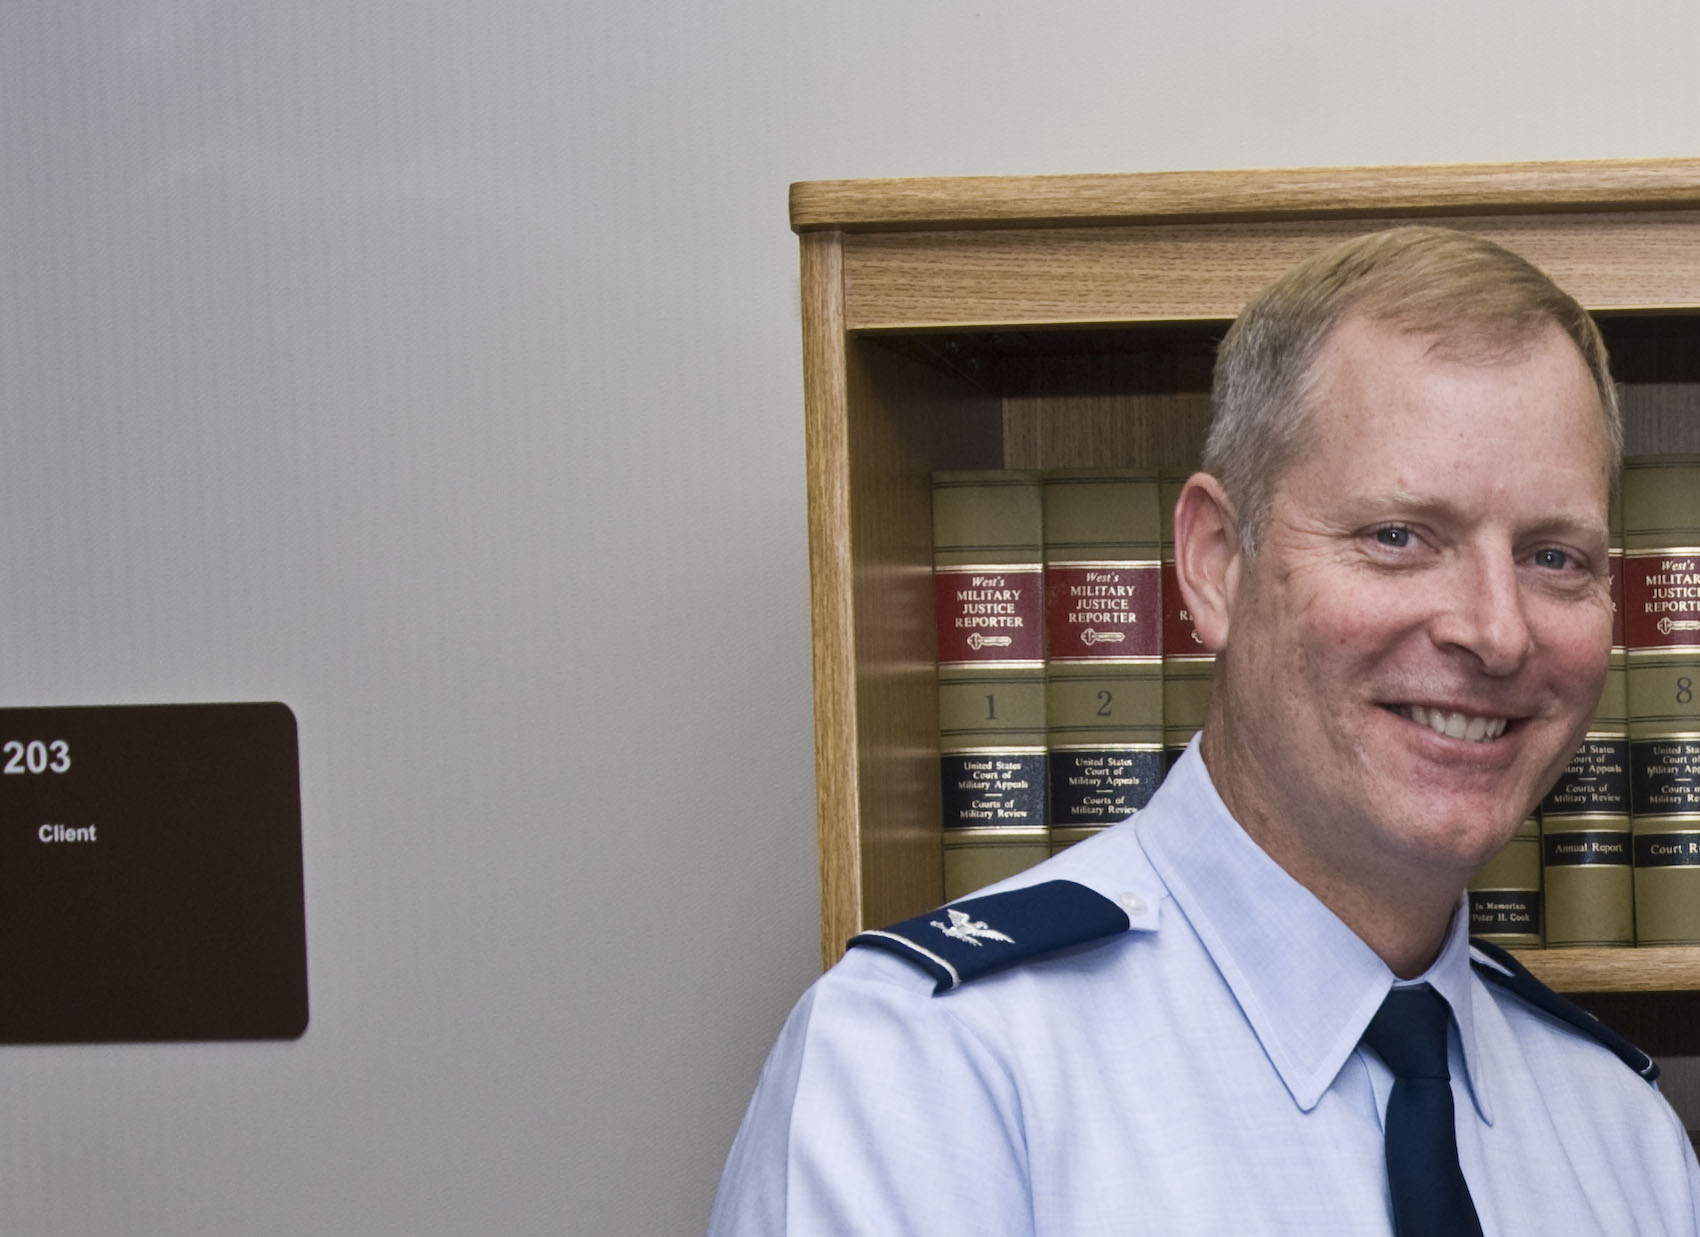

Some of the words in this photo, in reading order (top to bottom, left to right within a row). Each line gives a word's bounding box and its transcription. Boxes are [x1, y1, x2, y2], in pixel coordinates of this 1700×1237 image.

[1661, 559, 1695, 571] West's
[972, 575, 1005, 587] West's
[1086, 571, 1119, 583] West's
[957, 589, 1020, 601] MILITARY
[1070, 585, 1135, 597] MILITARY
[962, 603, 1015, 614] JUSTICE
[1076, 599, 1129, 610] JUSTICE
[955, 616, 1024, 628] REPORTER
[1069, 612, 1137, 623] REPORTER
[1676, 677, 1693, 703] 8
[985, 695, 998, 720] 1
[1096, 690, 1112, 716] 2
[3, 740, 71, 774] 203
[38, 824, 96, 843] Client
[1556, 843, 1588, 853] Annual
[1593, 842, 1622, 853] Report
[1650, 843, 1684, 855] Court
